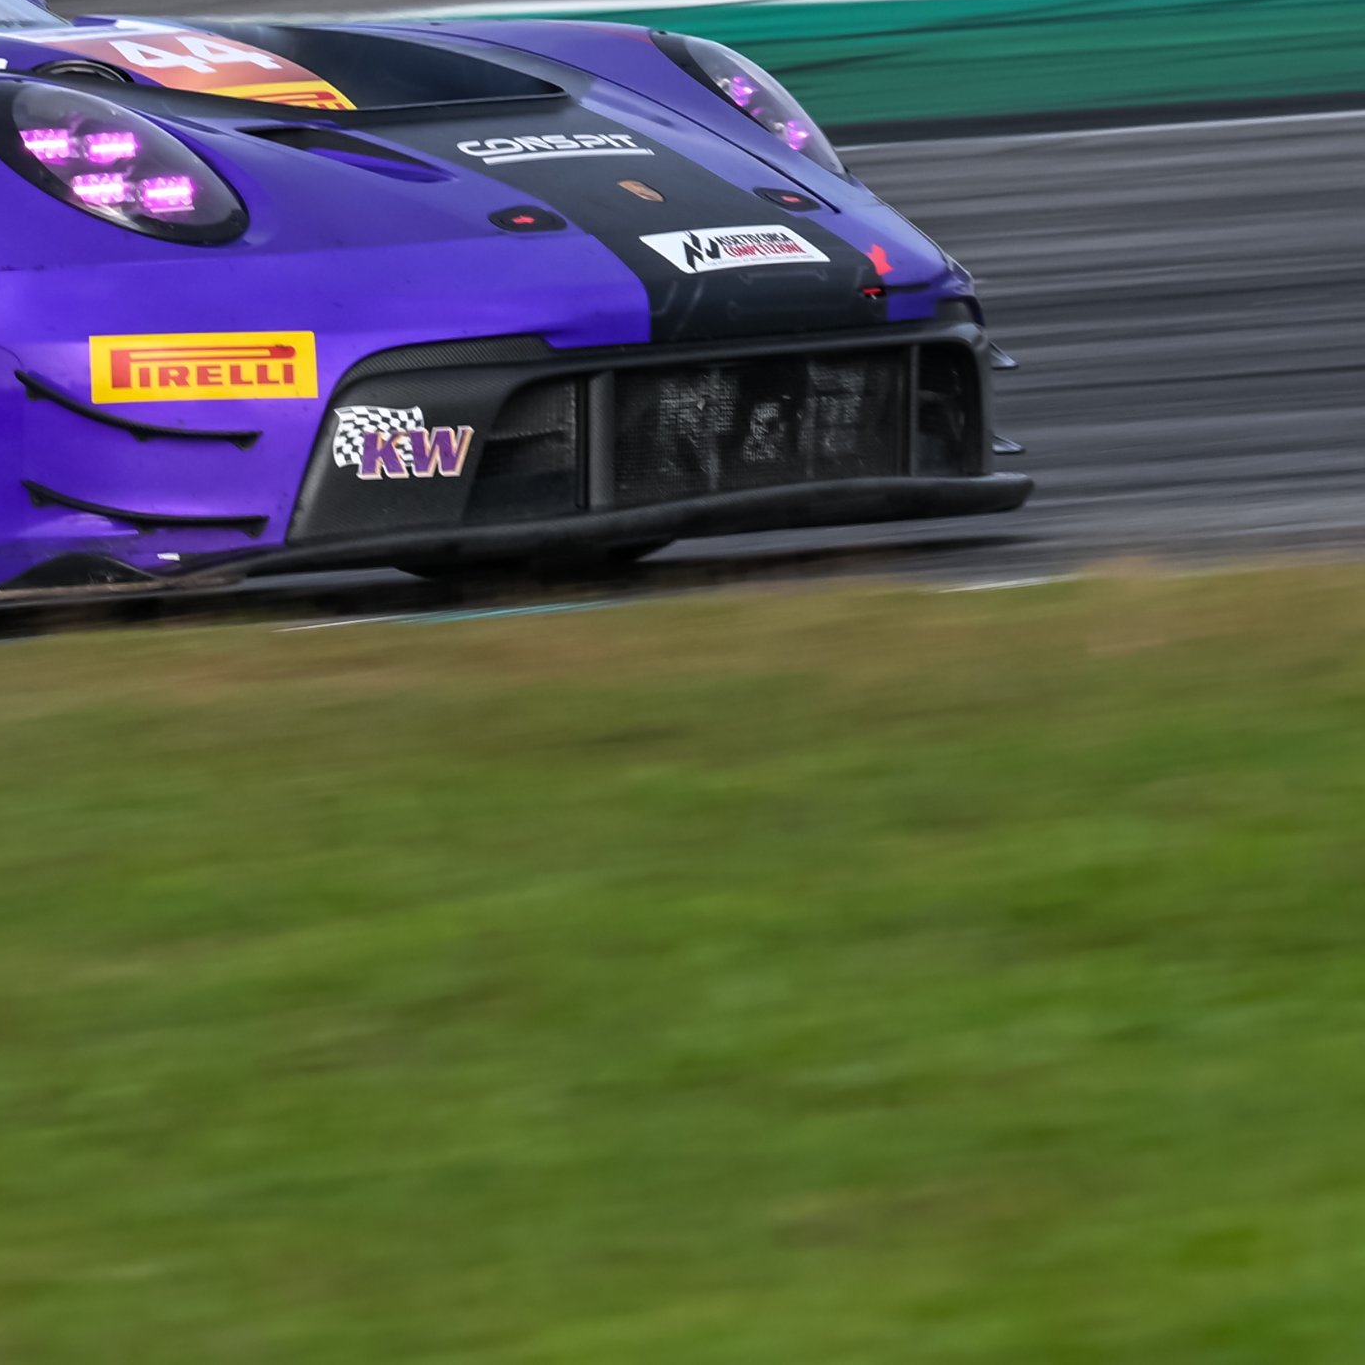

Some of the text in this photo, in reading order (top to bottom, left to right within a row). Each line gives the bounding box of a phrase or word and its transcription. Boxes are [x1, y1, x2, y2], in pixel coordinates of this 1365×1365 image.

[108, 36, 282, 74] 44
[109, 345, 297, 389] PIRELLI
[356, 425, 475, 481] KW
